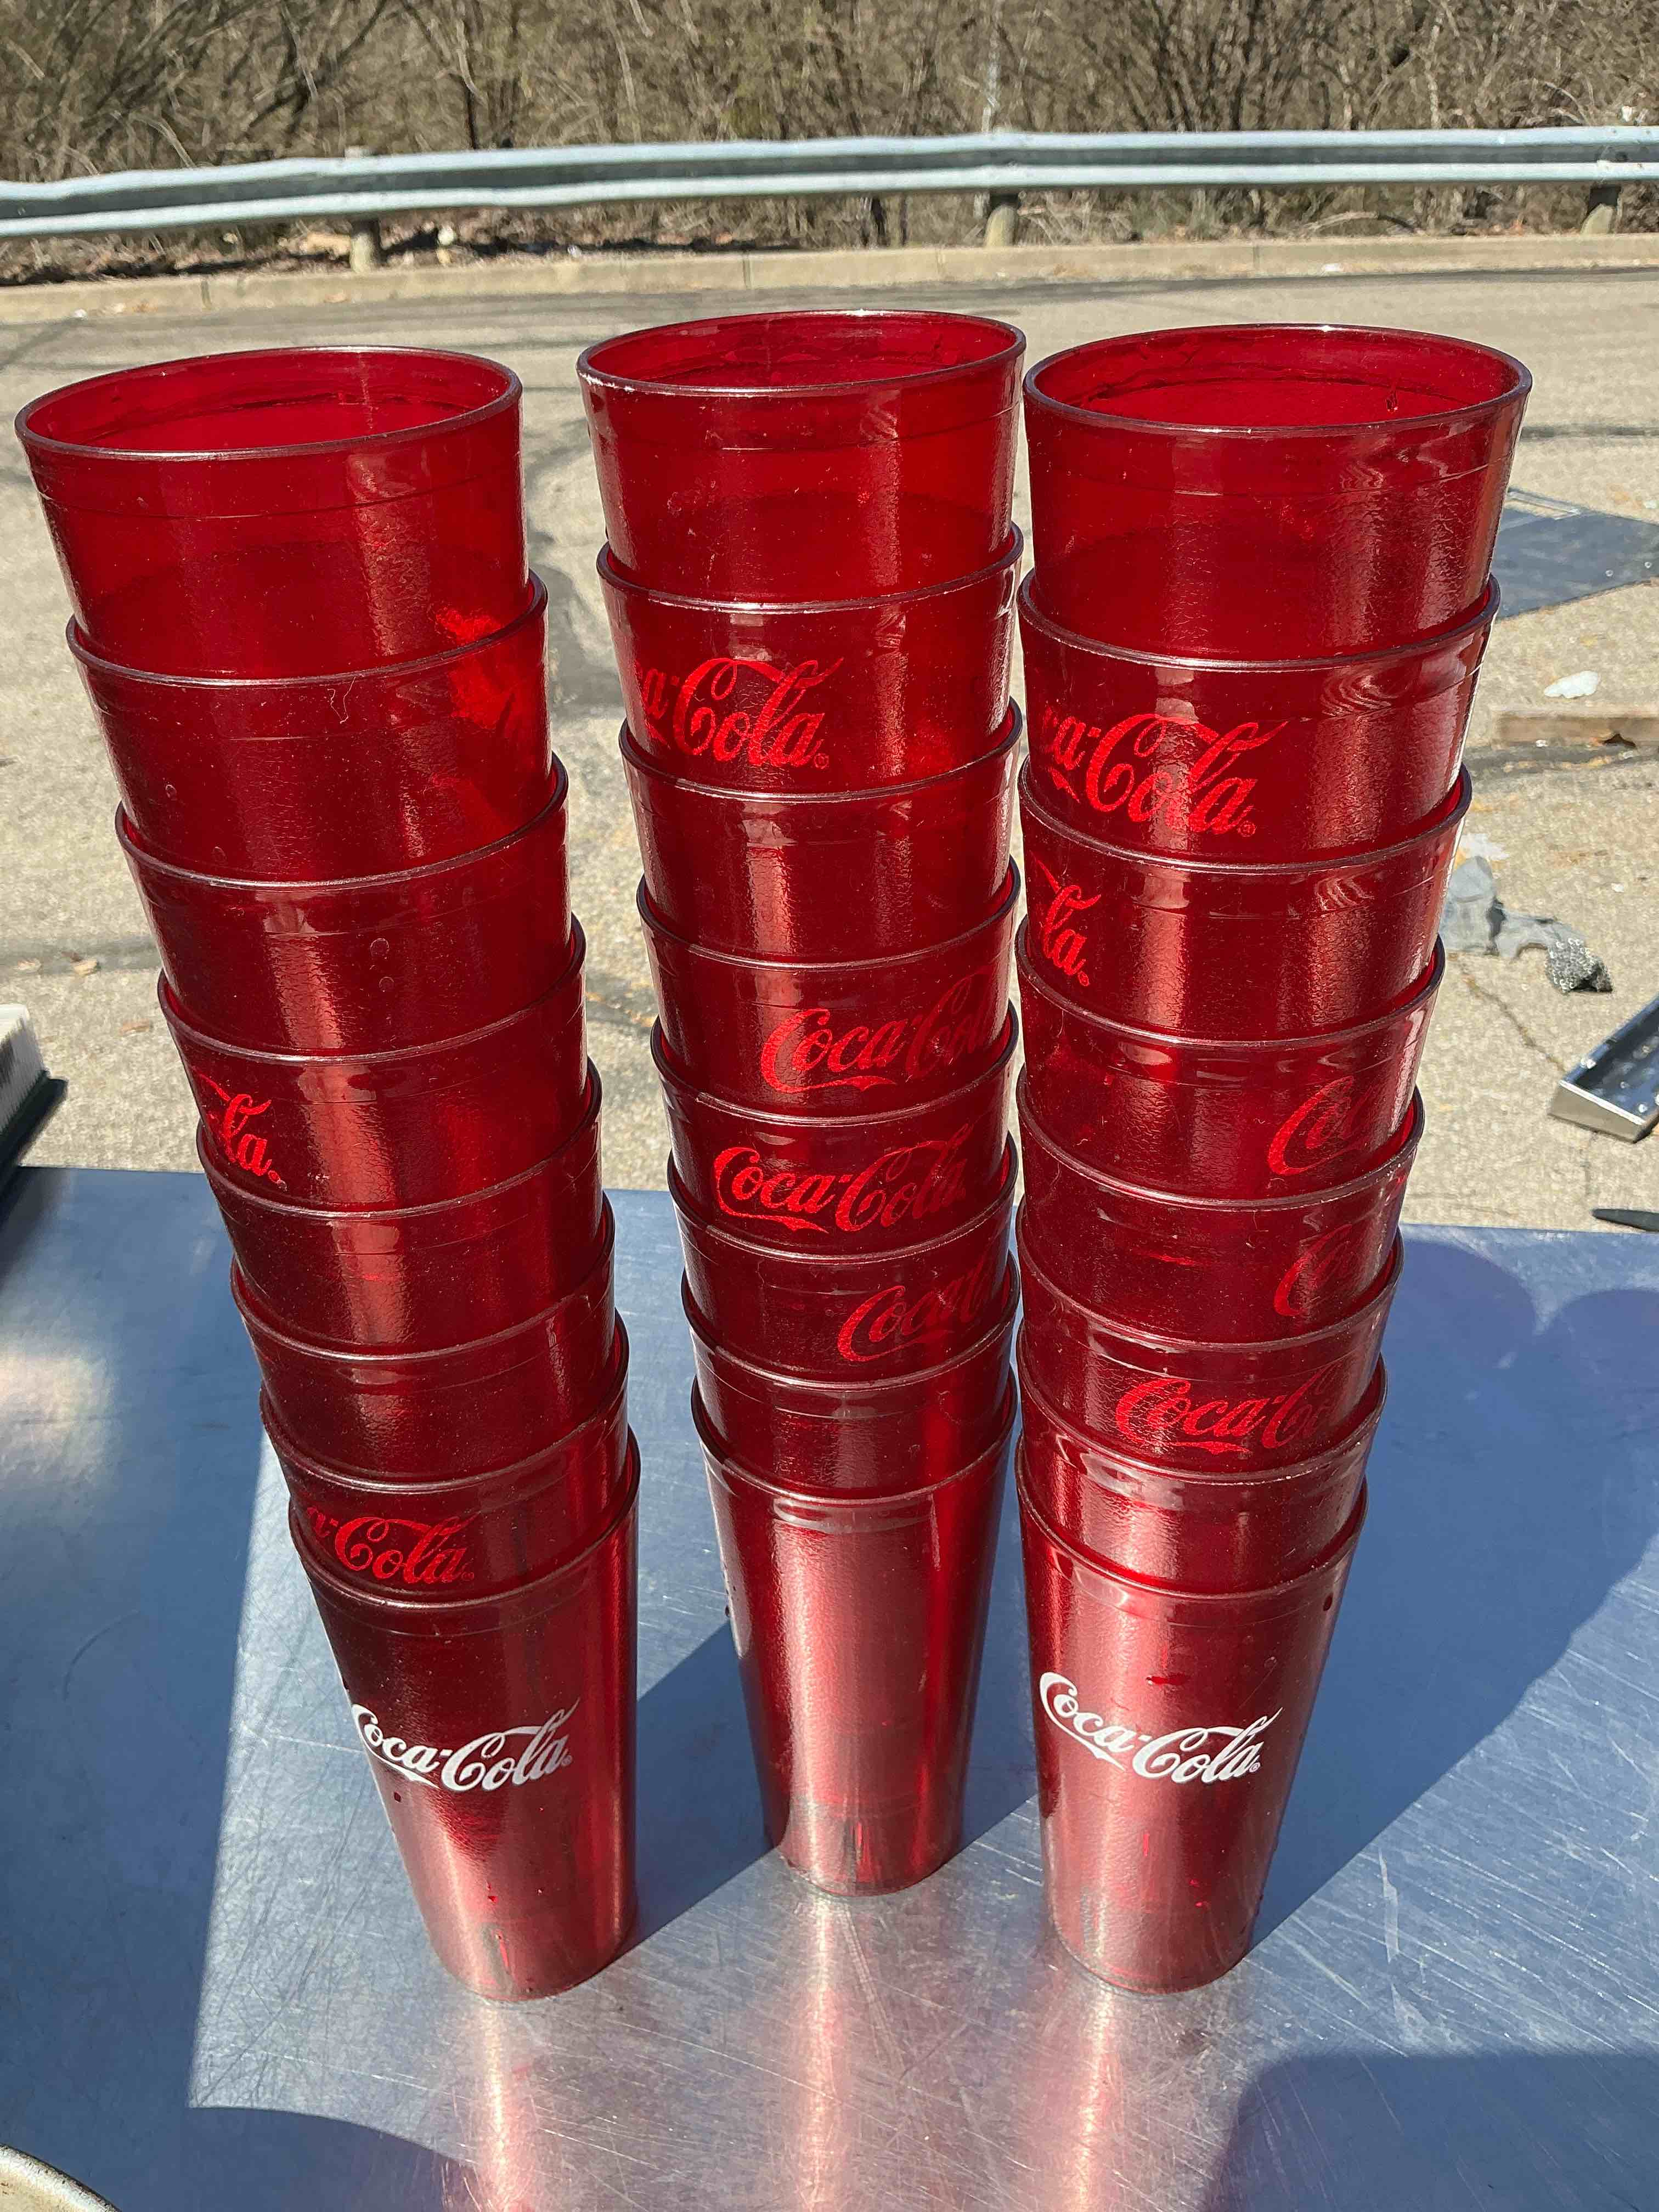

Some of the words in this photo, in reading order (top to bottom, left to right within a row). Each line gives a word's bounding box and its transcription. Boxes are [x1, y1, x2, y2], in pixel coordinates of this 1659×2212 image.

[714, 1120, 979, 1233] Coca-Cola
[351, 1697, 580, 1791] Coca-Cola
[1039, 1672, 1283, 1783] Coca-Cola
